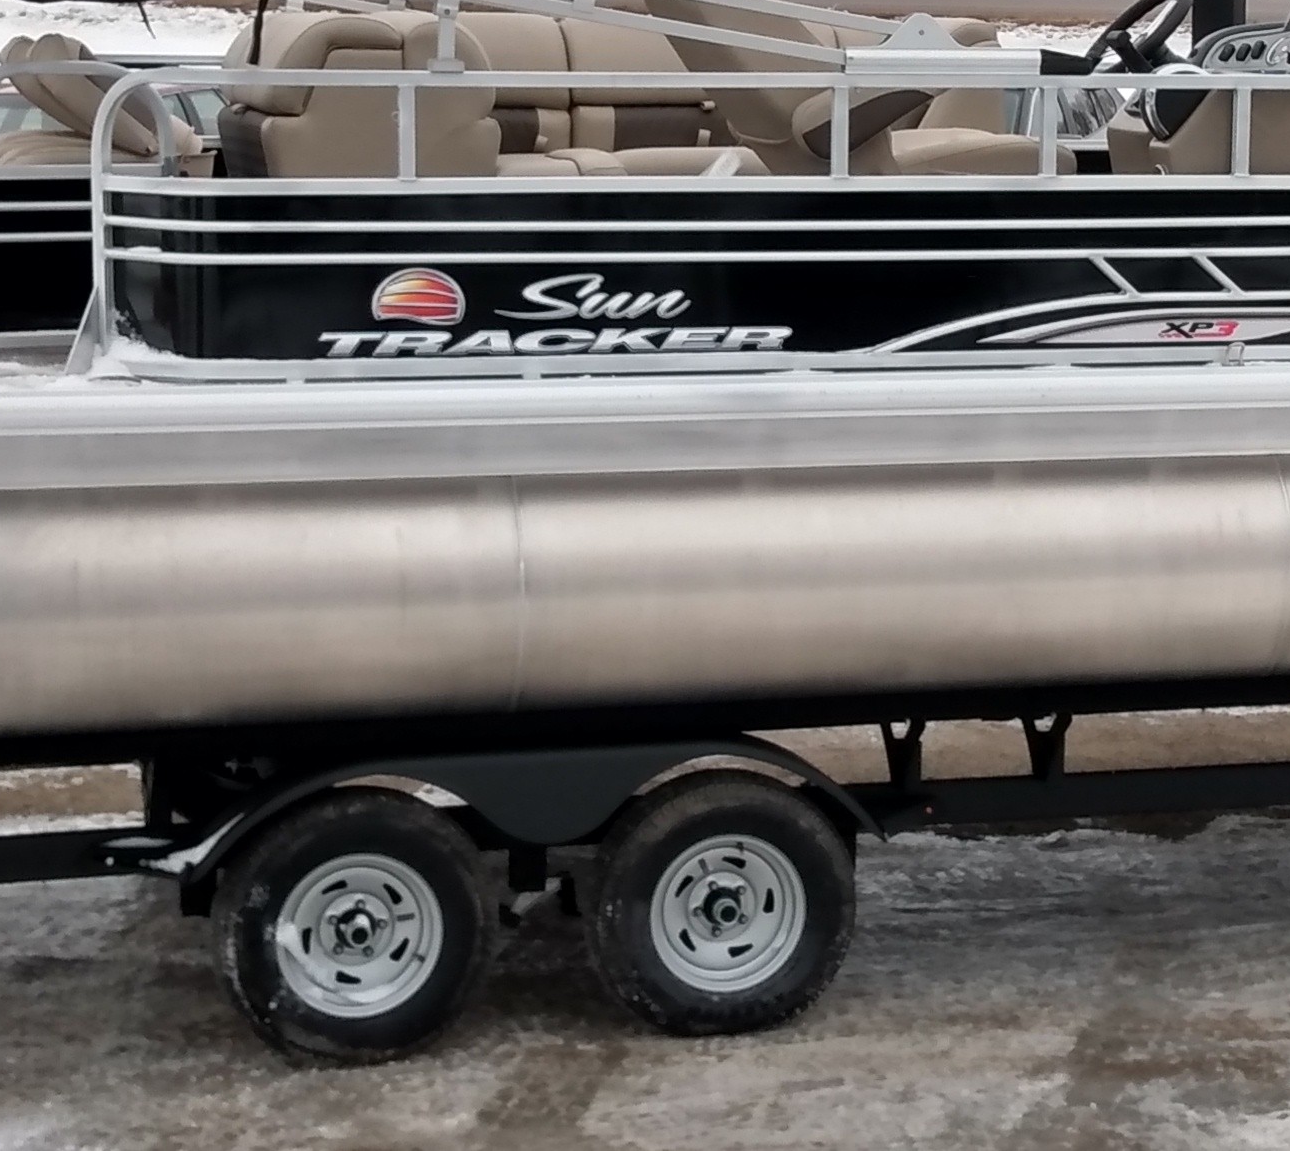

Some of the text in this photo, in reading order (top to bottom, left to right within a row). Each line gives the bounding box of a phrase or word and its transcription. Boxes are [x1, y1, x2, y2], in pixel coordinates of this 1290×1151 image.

[494, 273, 691, 319] Sun
[317, 325, 794, 357] TRACKER
[1161, 321, 1239, 338] XP3
